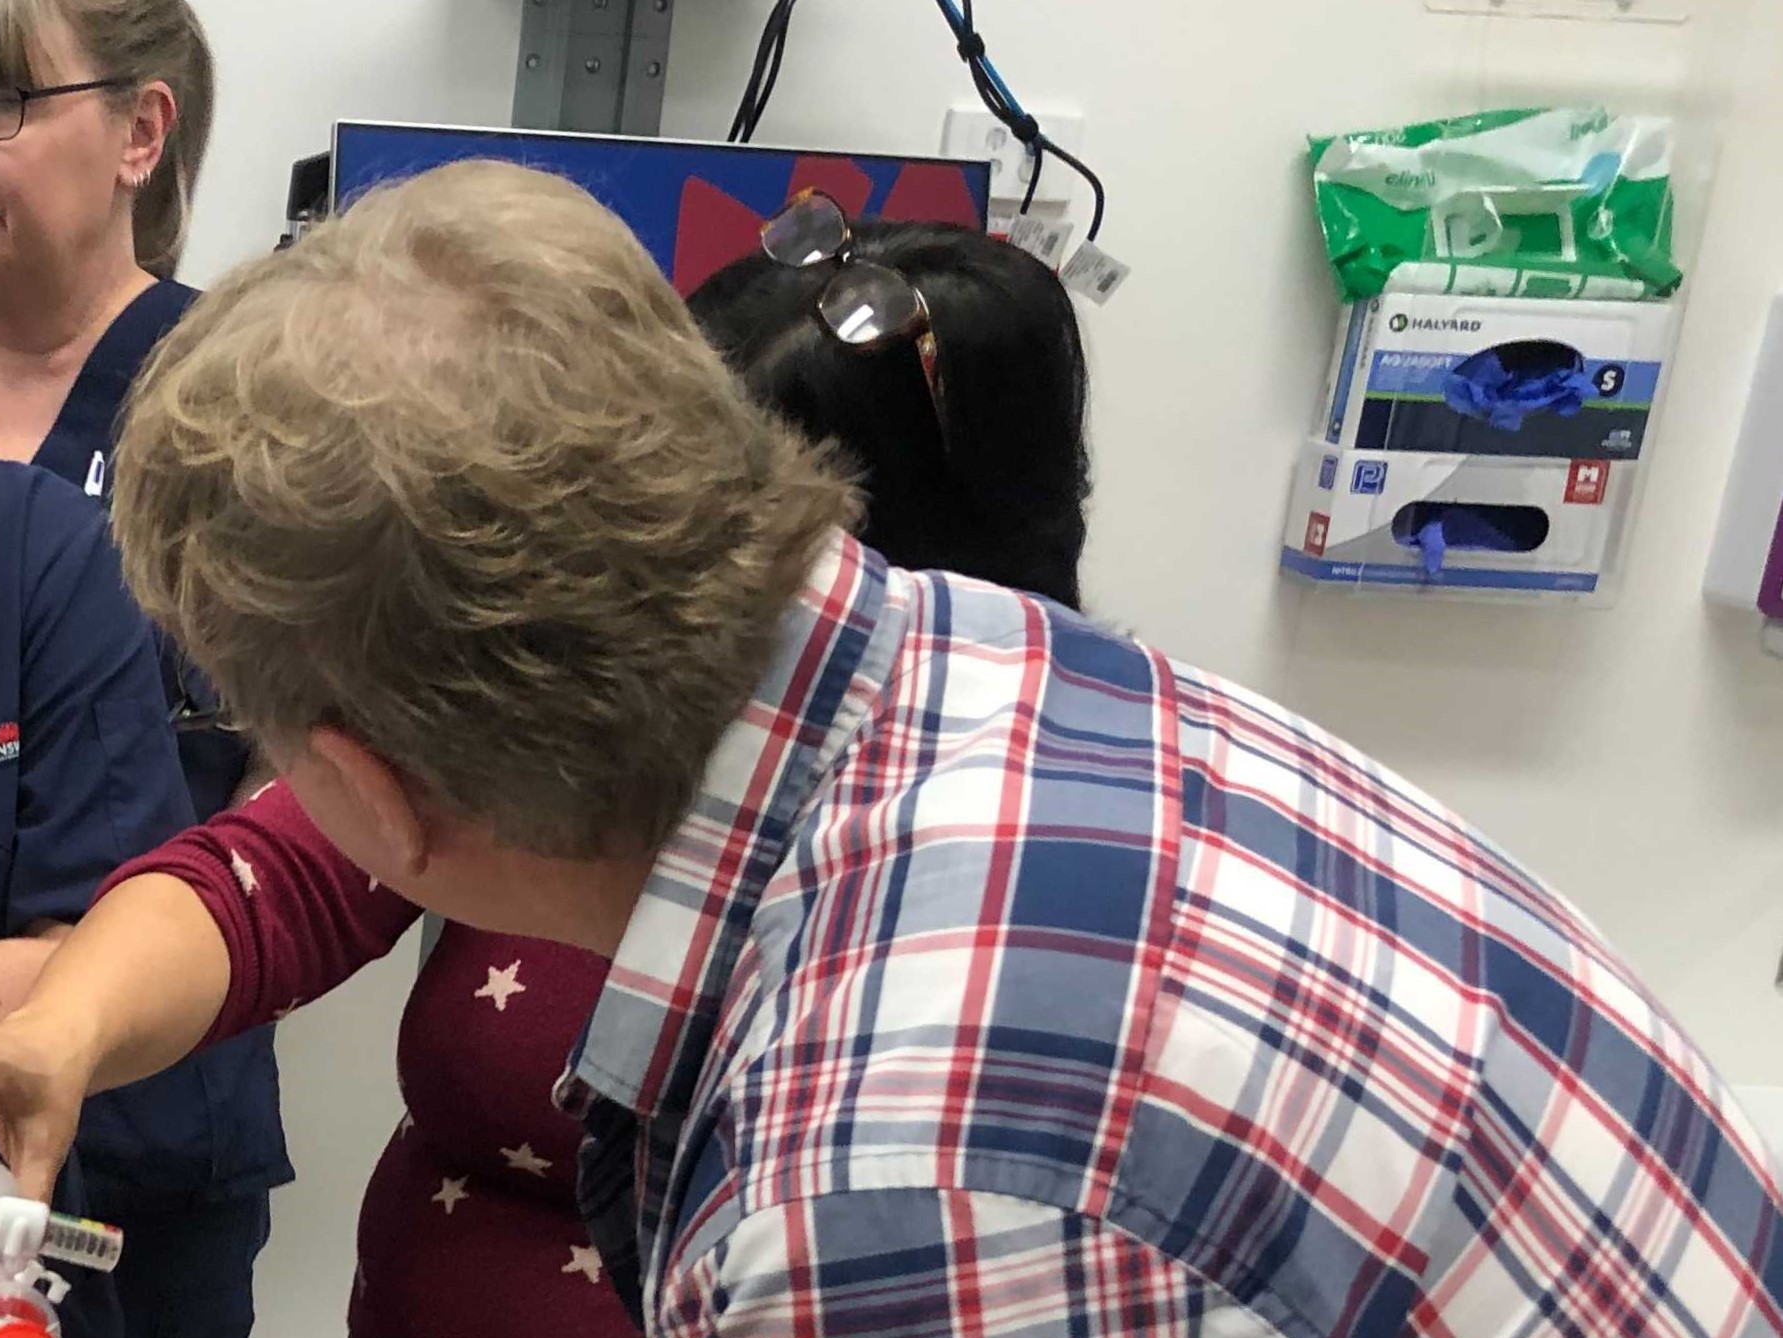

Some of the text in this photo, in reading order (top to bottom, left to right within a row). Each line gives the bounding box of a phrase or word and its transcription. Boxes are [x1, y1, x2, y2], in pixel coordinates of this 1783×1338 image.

[1411, 317, 1483, 333] HALYARD
[1600, 370, 1617, 391] S
[1576, 464, 1600, 482] M
